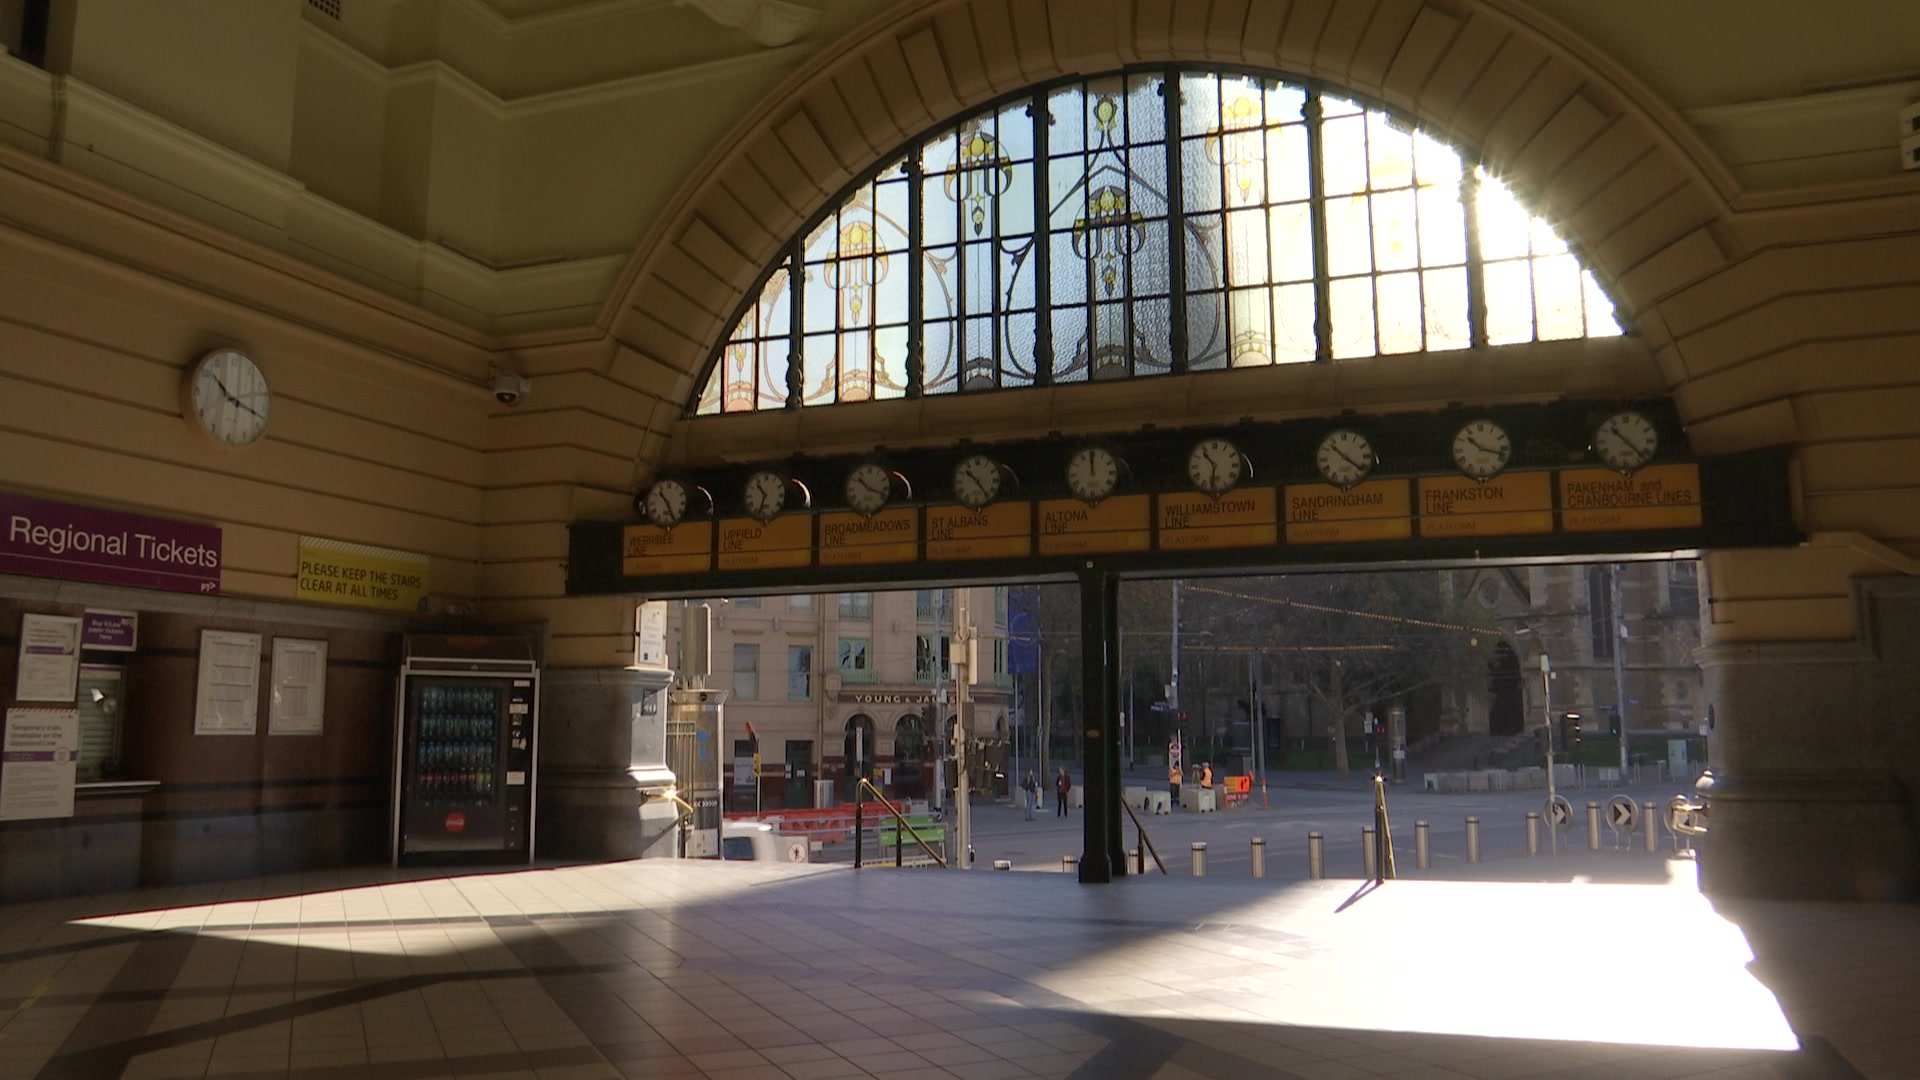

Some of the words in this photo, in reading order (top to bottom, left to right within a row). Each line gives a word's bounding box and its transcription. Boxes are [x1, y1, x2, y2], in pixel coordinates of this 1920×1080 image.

[1425, 486, 1503, 503] FRANKSTON
[1567, 480, 1634, 495] PAKENHAM
[1639, 480, 1662, 492] and
[1292, 494, 1384, 510] SANDRINGHAM
[1567, 491, 1655, 507] CRANBOURNE
[1658, 489, 1692, 505] LINES
[1166, 500, 1257, 516] WILLIAMSTOWN
[1425, 501, 1454, 514] LINE
[931, 517, 945, 529] ST
[946, 515, 988, 529] ALBANS
[1046, 509, 1088, 523] ALTONA
[1292, 509, 1319, 521] LINE
[825, 519, 911, 536] BROADMEADOWS
[1045, 521, 1067, 535] LINE
[1165, 516, 1190, 529] LINE
[9, 514, 127, 554] Regional
[134, 533, 218, 568] Tickets
[723, 528, 761, 541] UPFIELD
[825, 534, 846, 546] LINE
[931, 528, 954, 541] LINE
[723, 539, 743, 551] LINE
[302, 561, 339, 578] PLEASE
[342, 567, 367, 581] KEEP
[370, 570, 388, 585] THE
[390, 573, 422, 589] STAIRS
[300, 577, 332, 593] CLEAR
[335, 582, 348, 595] AT
[350, 583, 368, 598] ALL
[370, 586, 399, 601] TIMES
[855, 695, 901, 704] YOUNG
